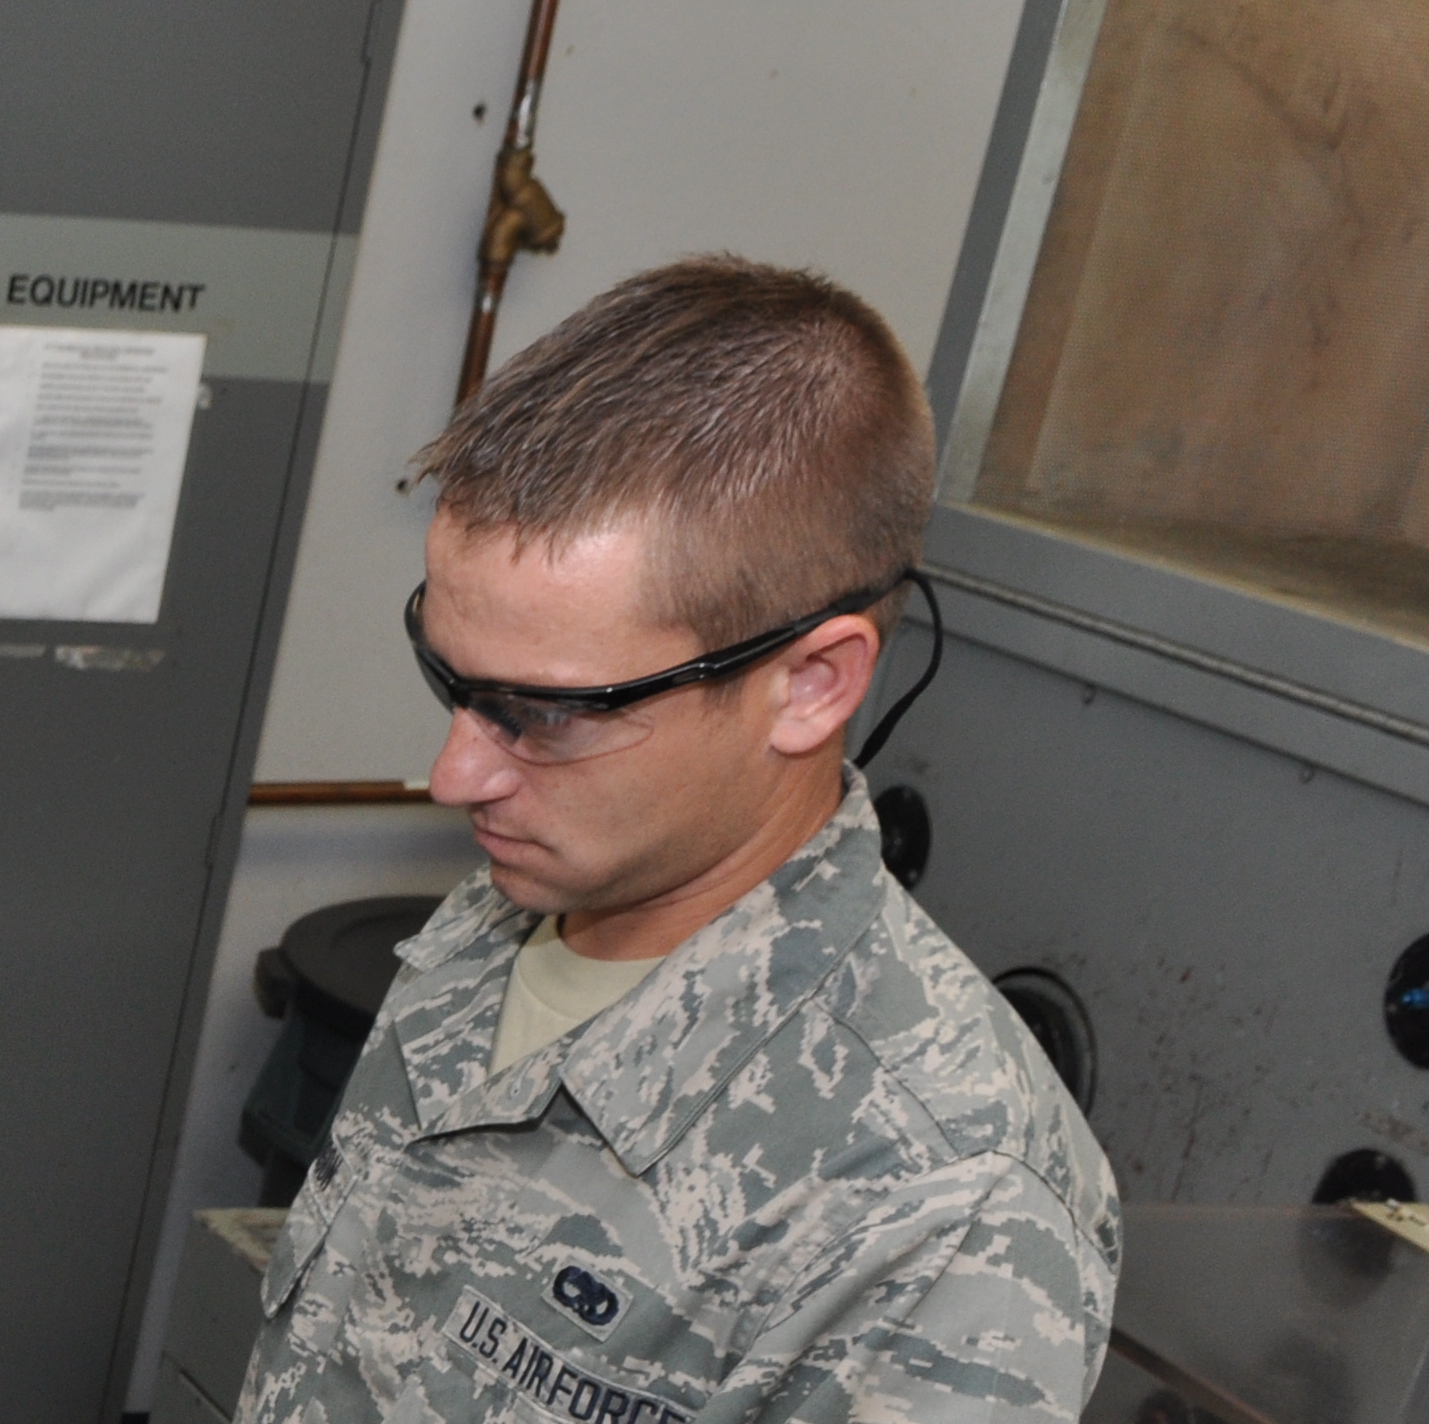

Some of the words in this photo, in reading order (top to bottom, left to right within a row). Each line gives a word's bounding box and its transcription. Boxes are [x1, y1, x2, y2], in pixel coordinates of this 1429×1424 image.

[7, 274, 205, 312] EQUIPMENT
[460, 1301, 506, 1363] U.S.
[502, 1337, 554, 1398] AIR
